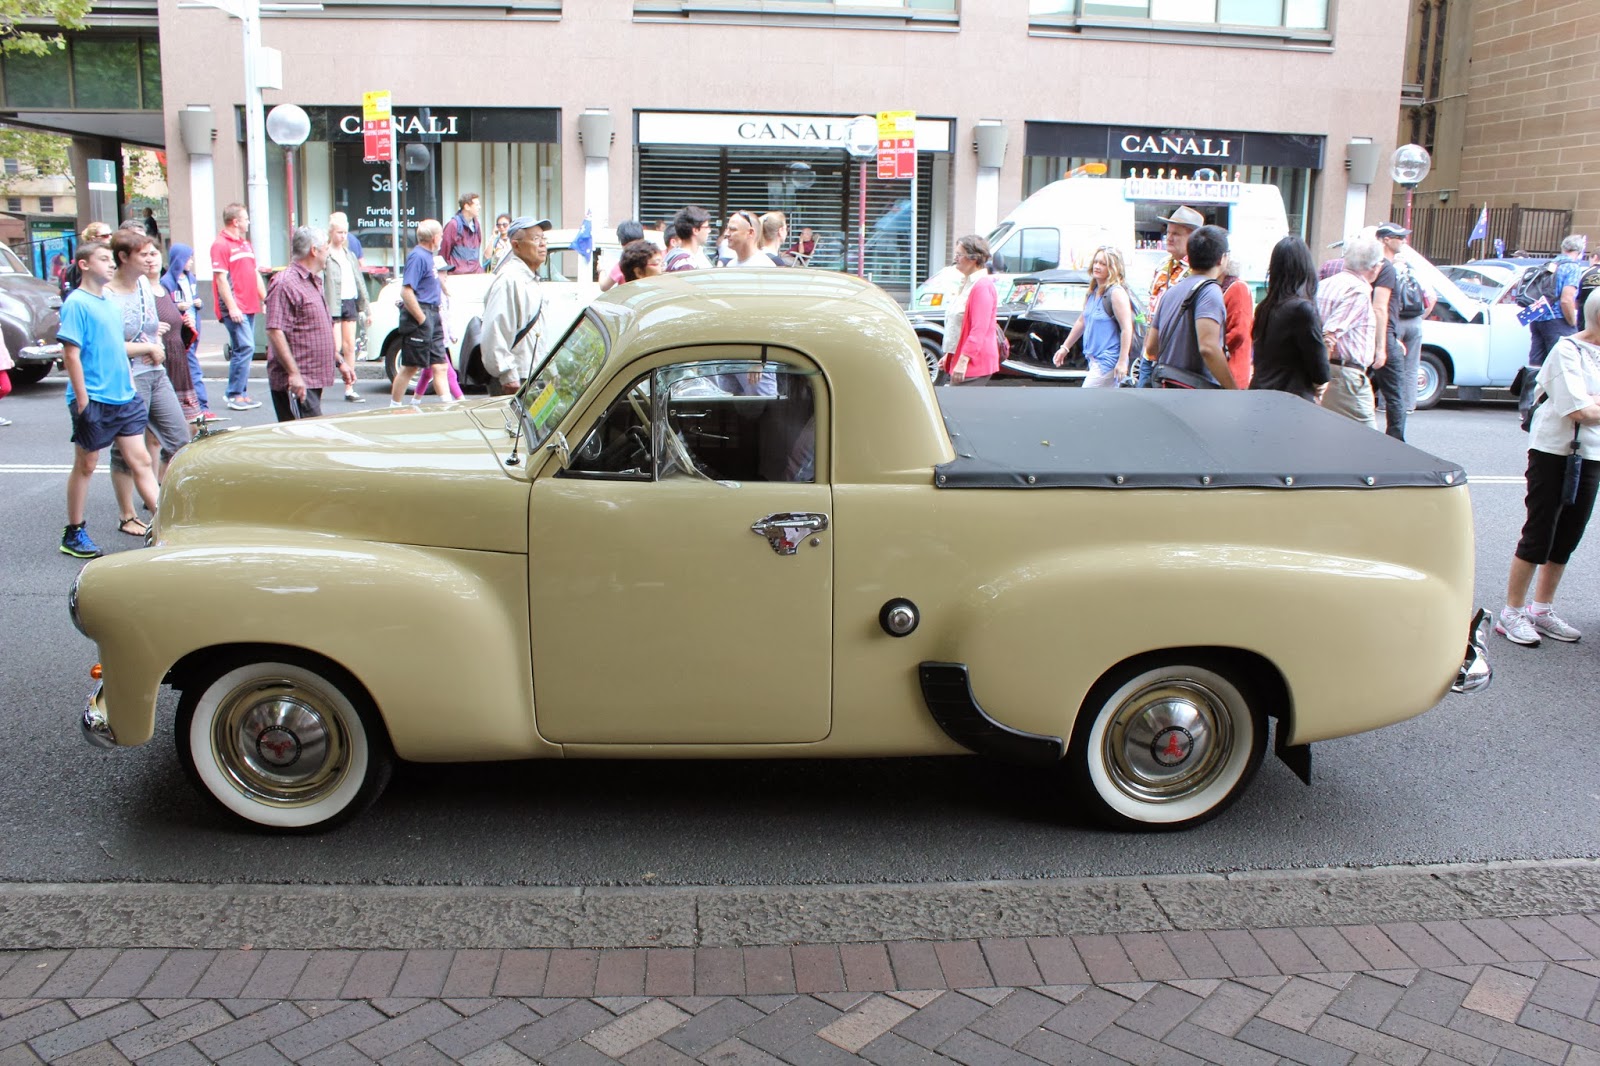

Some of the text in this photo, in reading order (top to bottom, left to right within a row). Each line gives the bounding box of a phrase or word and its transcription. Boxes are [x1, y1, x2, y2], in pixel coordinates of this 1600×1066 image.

[340, 115, 458, 134] CNALI
[1121, 135, 1230, 157] CANALI
[372, 173, 408, 192] Sae
[366, 206, 394, 216] Furthe
[357, 218, 420, 228] Final Recion
